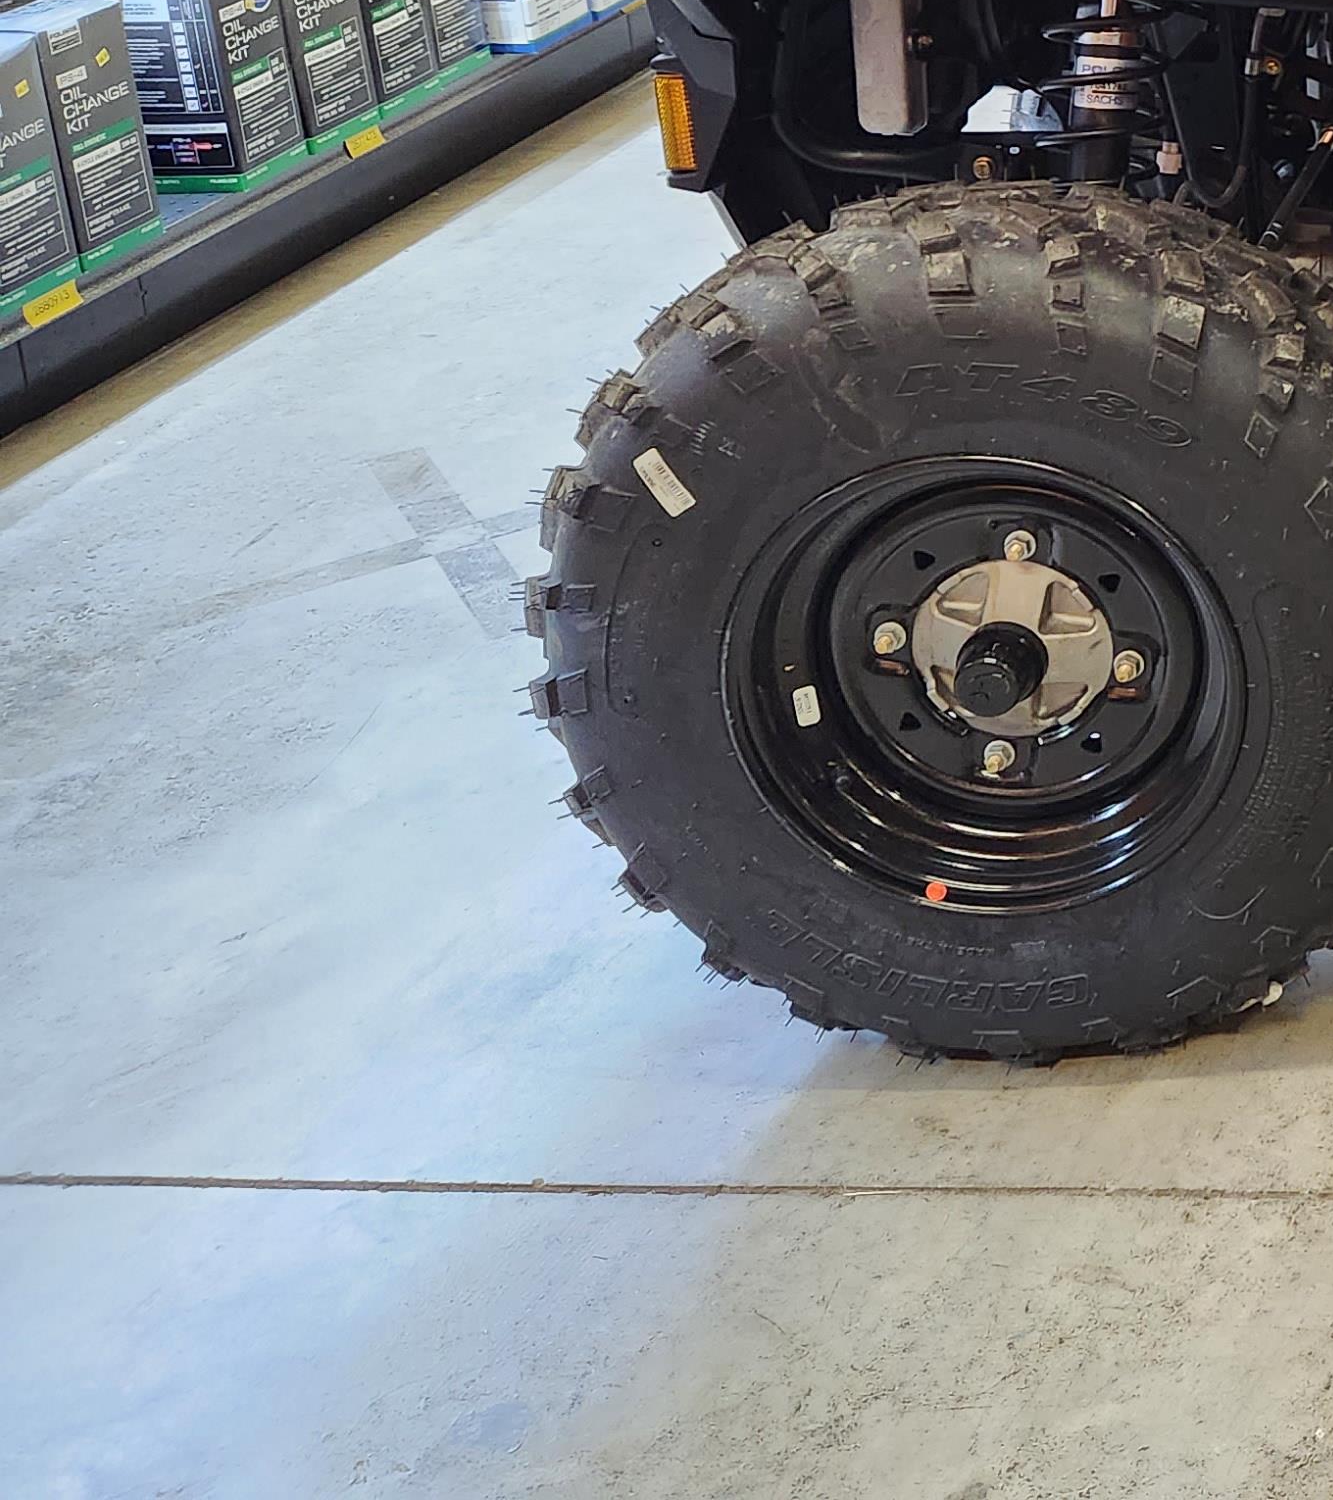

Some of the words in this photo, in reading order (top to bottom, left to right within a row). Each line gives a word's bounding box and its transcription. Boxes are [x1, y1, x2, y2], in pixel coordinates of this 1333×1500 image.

[222, 18, 246, 37] OIL
[225, 15, 280, 51] CHANGE
[299, 13, 322, 32] KIT
[227, 45, 251, 65] KIT
[60, 84, 88, 105] OIL
[63, 80, 131, 119] CHANGE
[1, 117, 46, 151] ANGE
[66, 113, 92, 135] KIT
[768, 907, 1089, 1015] CARLISLE
